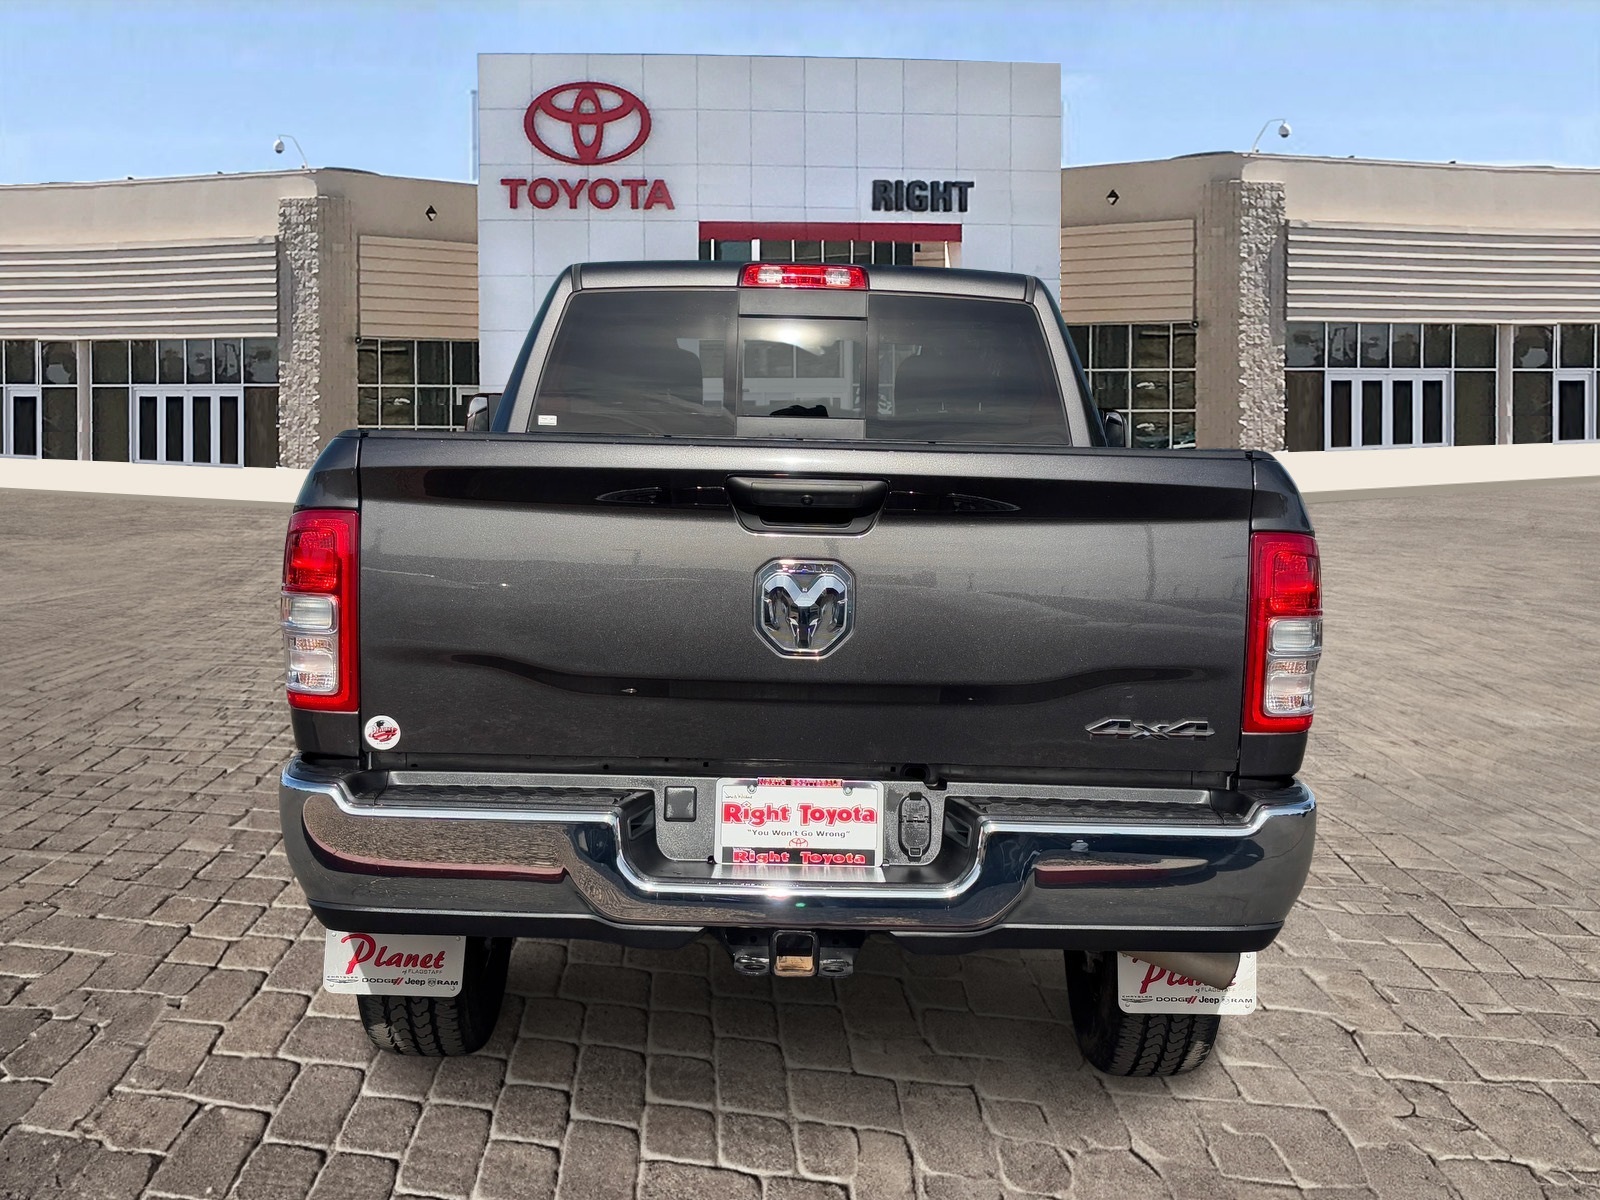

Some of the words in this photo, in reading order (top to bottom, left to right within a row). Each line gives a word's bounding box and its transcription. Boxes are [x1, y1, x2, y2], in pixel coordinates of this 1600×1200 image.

[500, 178, 675, 210] TOYOTA
[871, 179, 974, 213] RIGHT
[722, 801, 791, 827] Right
[797, 803, 877, 827] Toyota
[772, 829, 798, 837] Won't
[732, 849, 790, 864] Right
[800, 851, 866, 865] Toyota
[341, 933, 446, 975] Planet
[404, 977, 426, 987] Jeep
[1198, 996, 1220, 1004] Jeep
